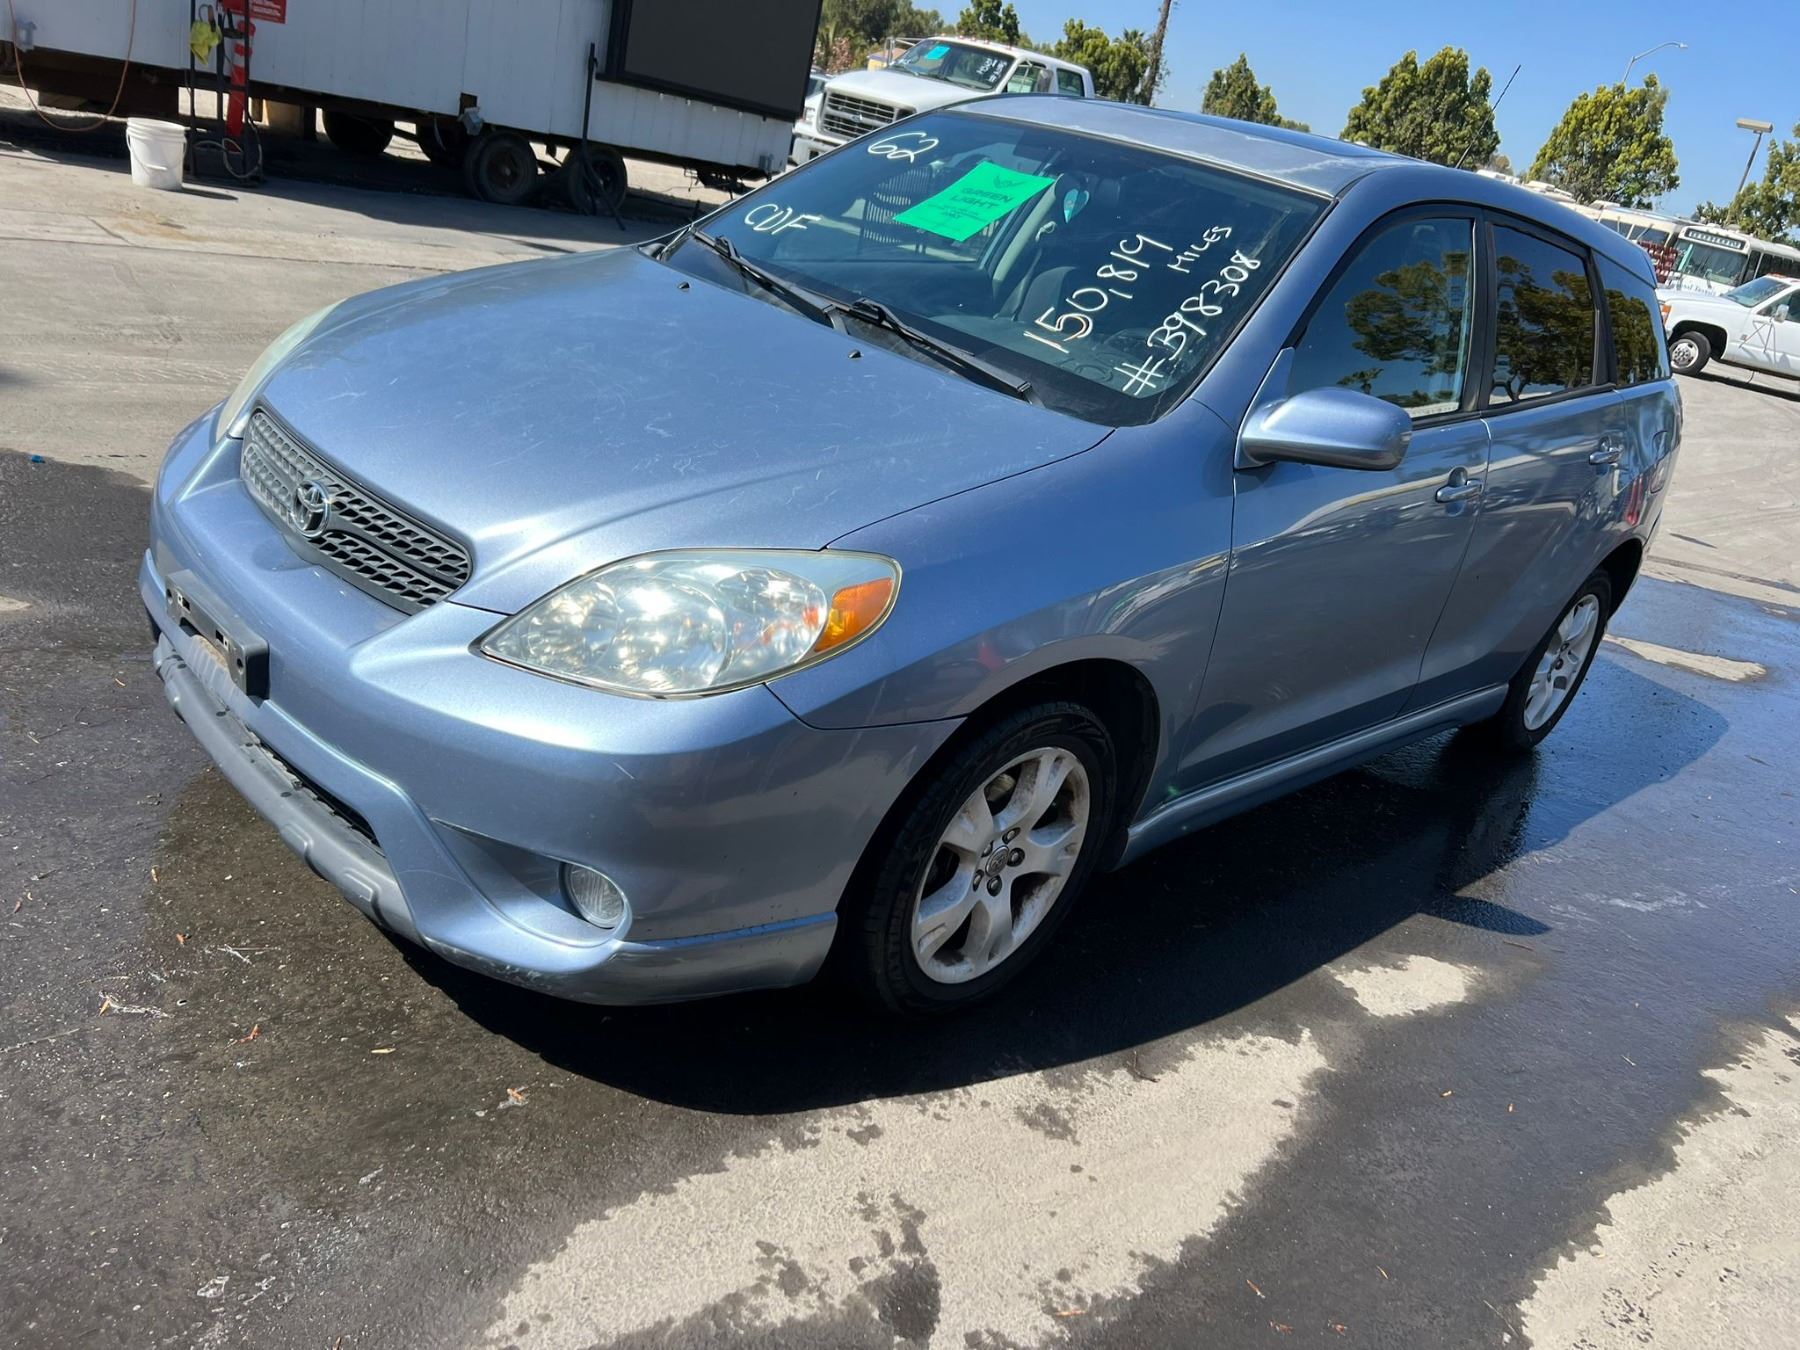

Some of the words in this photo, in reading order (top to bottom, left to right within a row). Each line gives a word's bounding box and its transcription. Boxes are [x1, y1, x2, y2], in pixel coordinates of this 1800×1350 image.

[867, 132, 939, 163] 62
[951, 195, 999, 209] LIGHT
[961, 187, 1013, 203] GREEN
[1167, 226, 1232, 273] MILES
